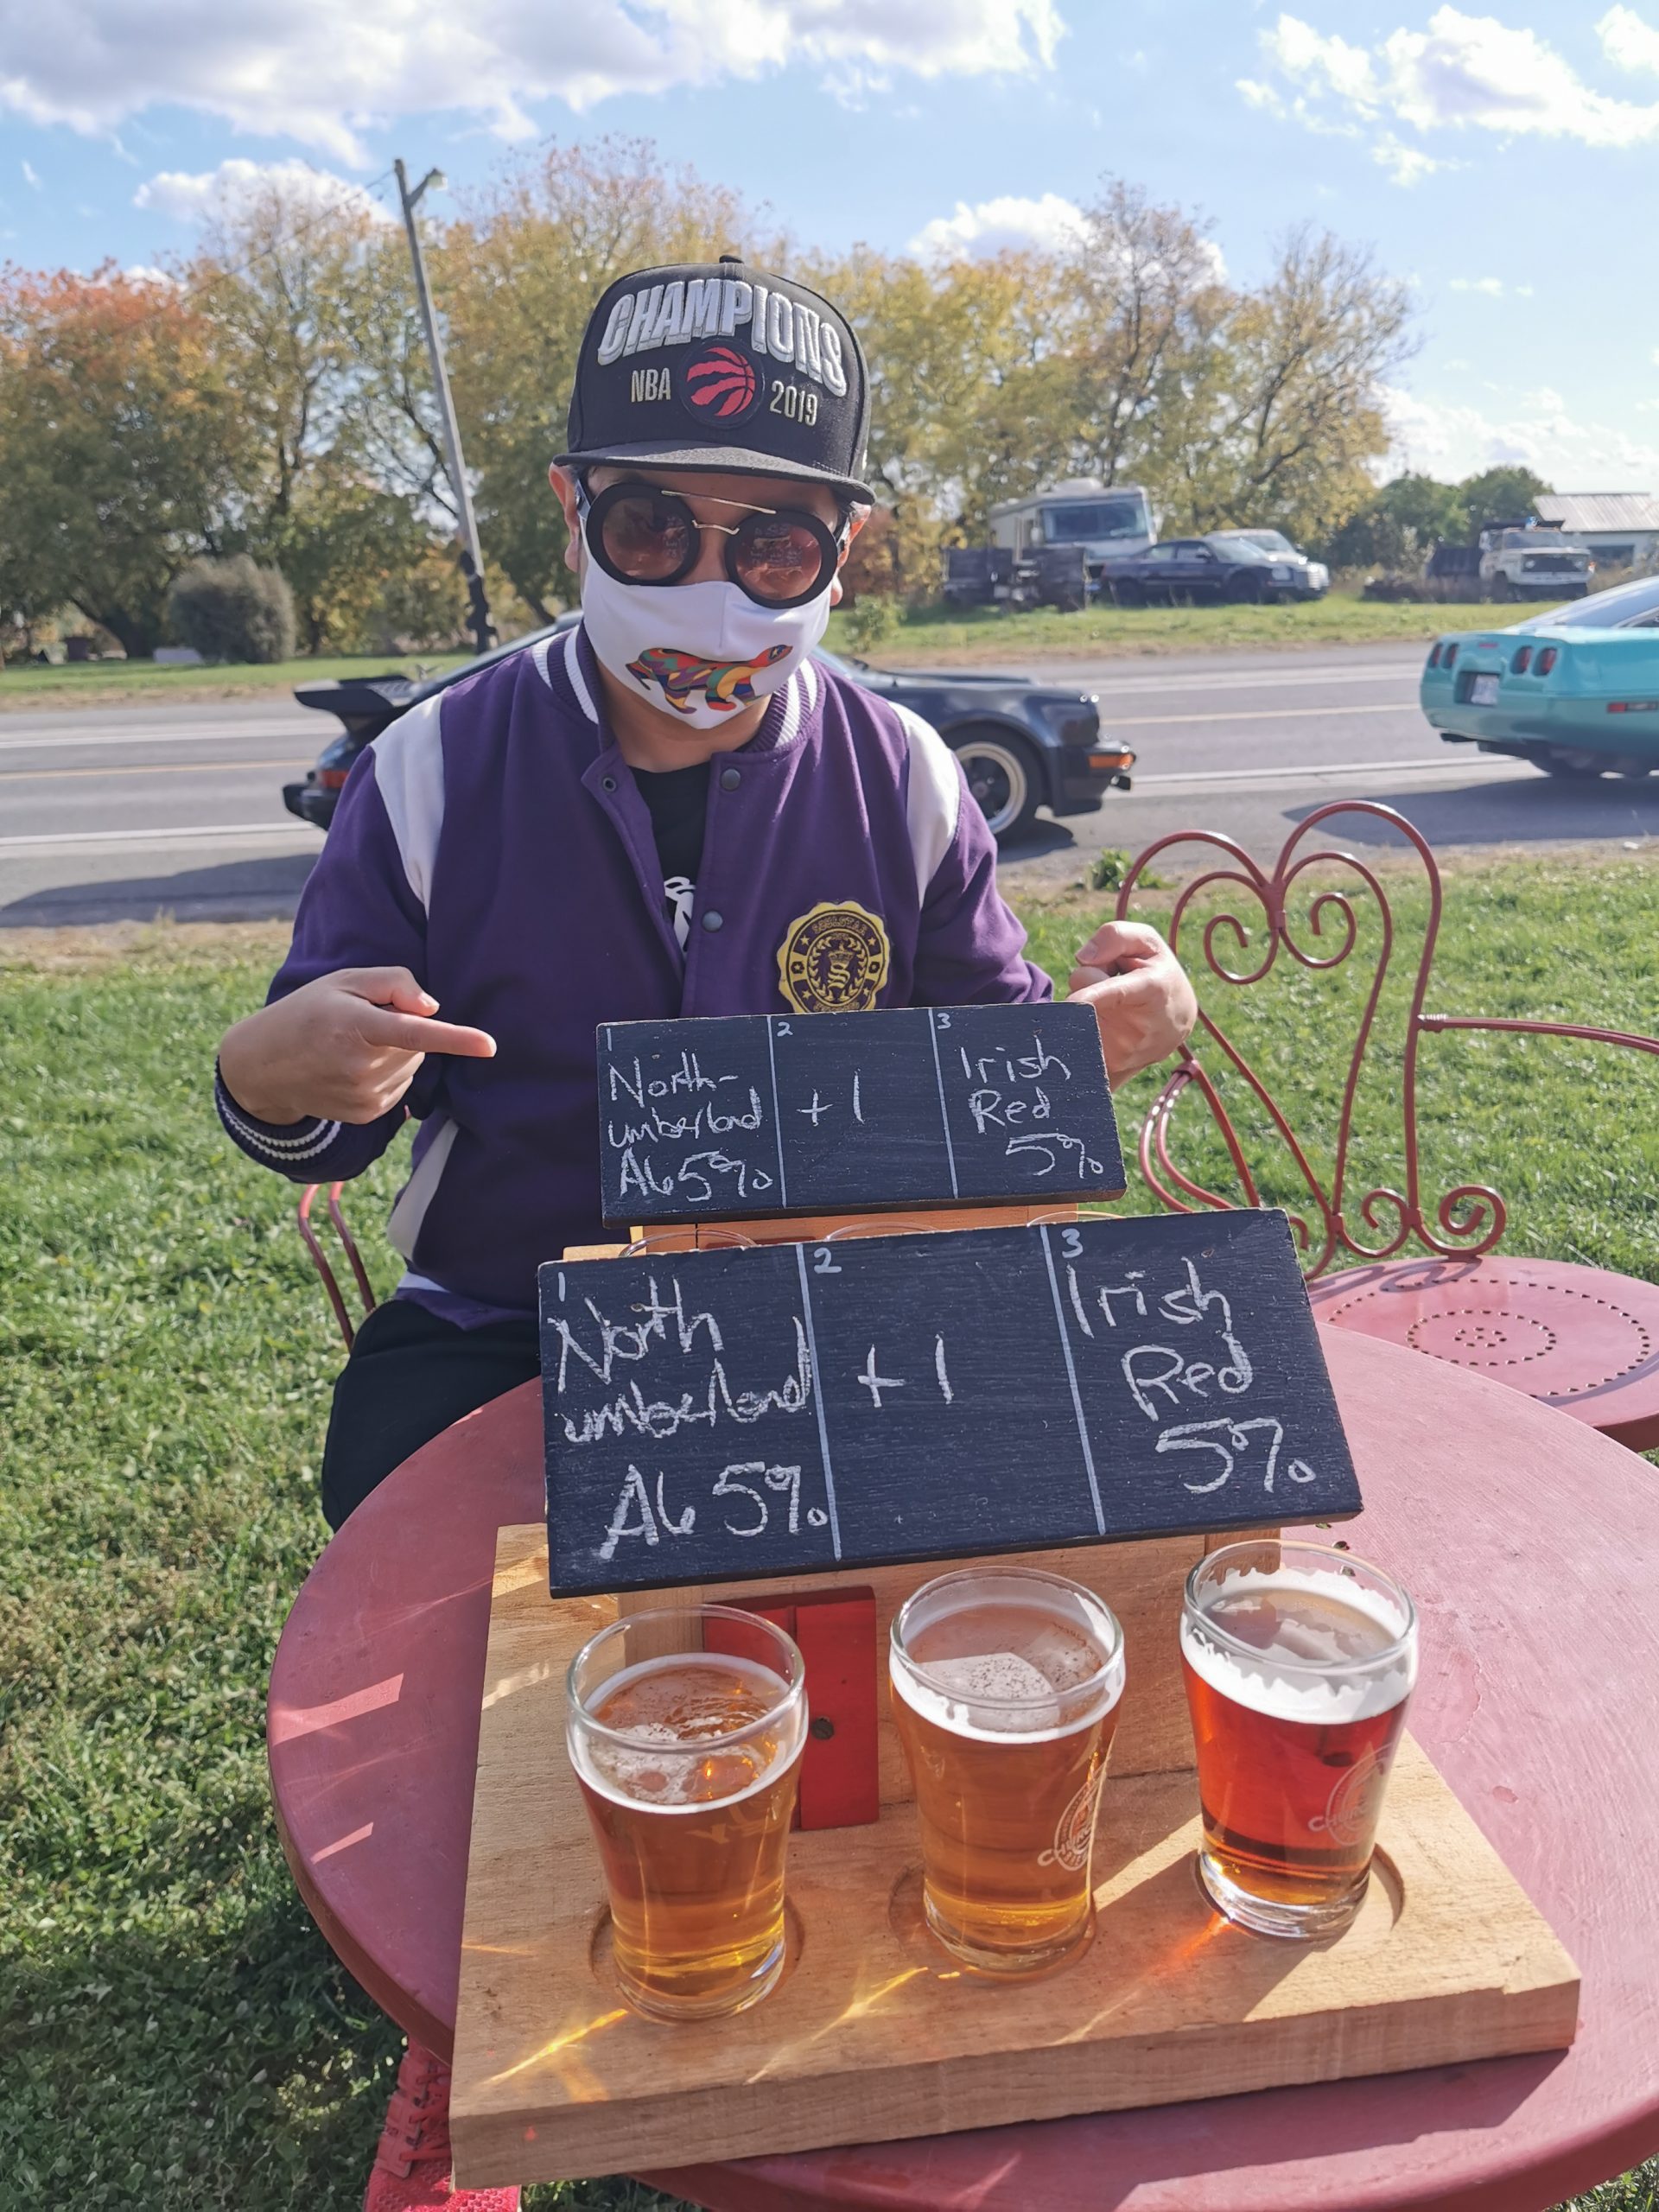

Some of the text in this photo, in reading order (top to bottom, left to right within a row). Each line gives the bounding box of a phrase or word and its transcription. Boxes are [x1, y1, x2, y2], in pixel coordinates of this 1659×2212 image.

[597, 278, 847, 397] CHAMPIONS
[631, 367, 818, 427] NBA 2019
[778, 1021, 793, 1036] 2
[937, 1012, 951, 1030] 3
[960, 1034, 1071, 1084] Irish
[968, 1086, 1052, 1134] Red
[813, 1247, 842, 1274] 2
[1061, 1228, 1084, 1258] 3
[1065, 1256, 1233, 1338] Irish
[548, 1275, 725, 1394] North
[1122, 1331, 1254, 1421] Red
[1154, 1418, 1317, 1494] 5%
[712, 1461, 829, 1536] 5%
